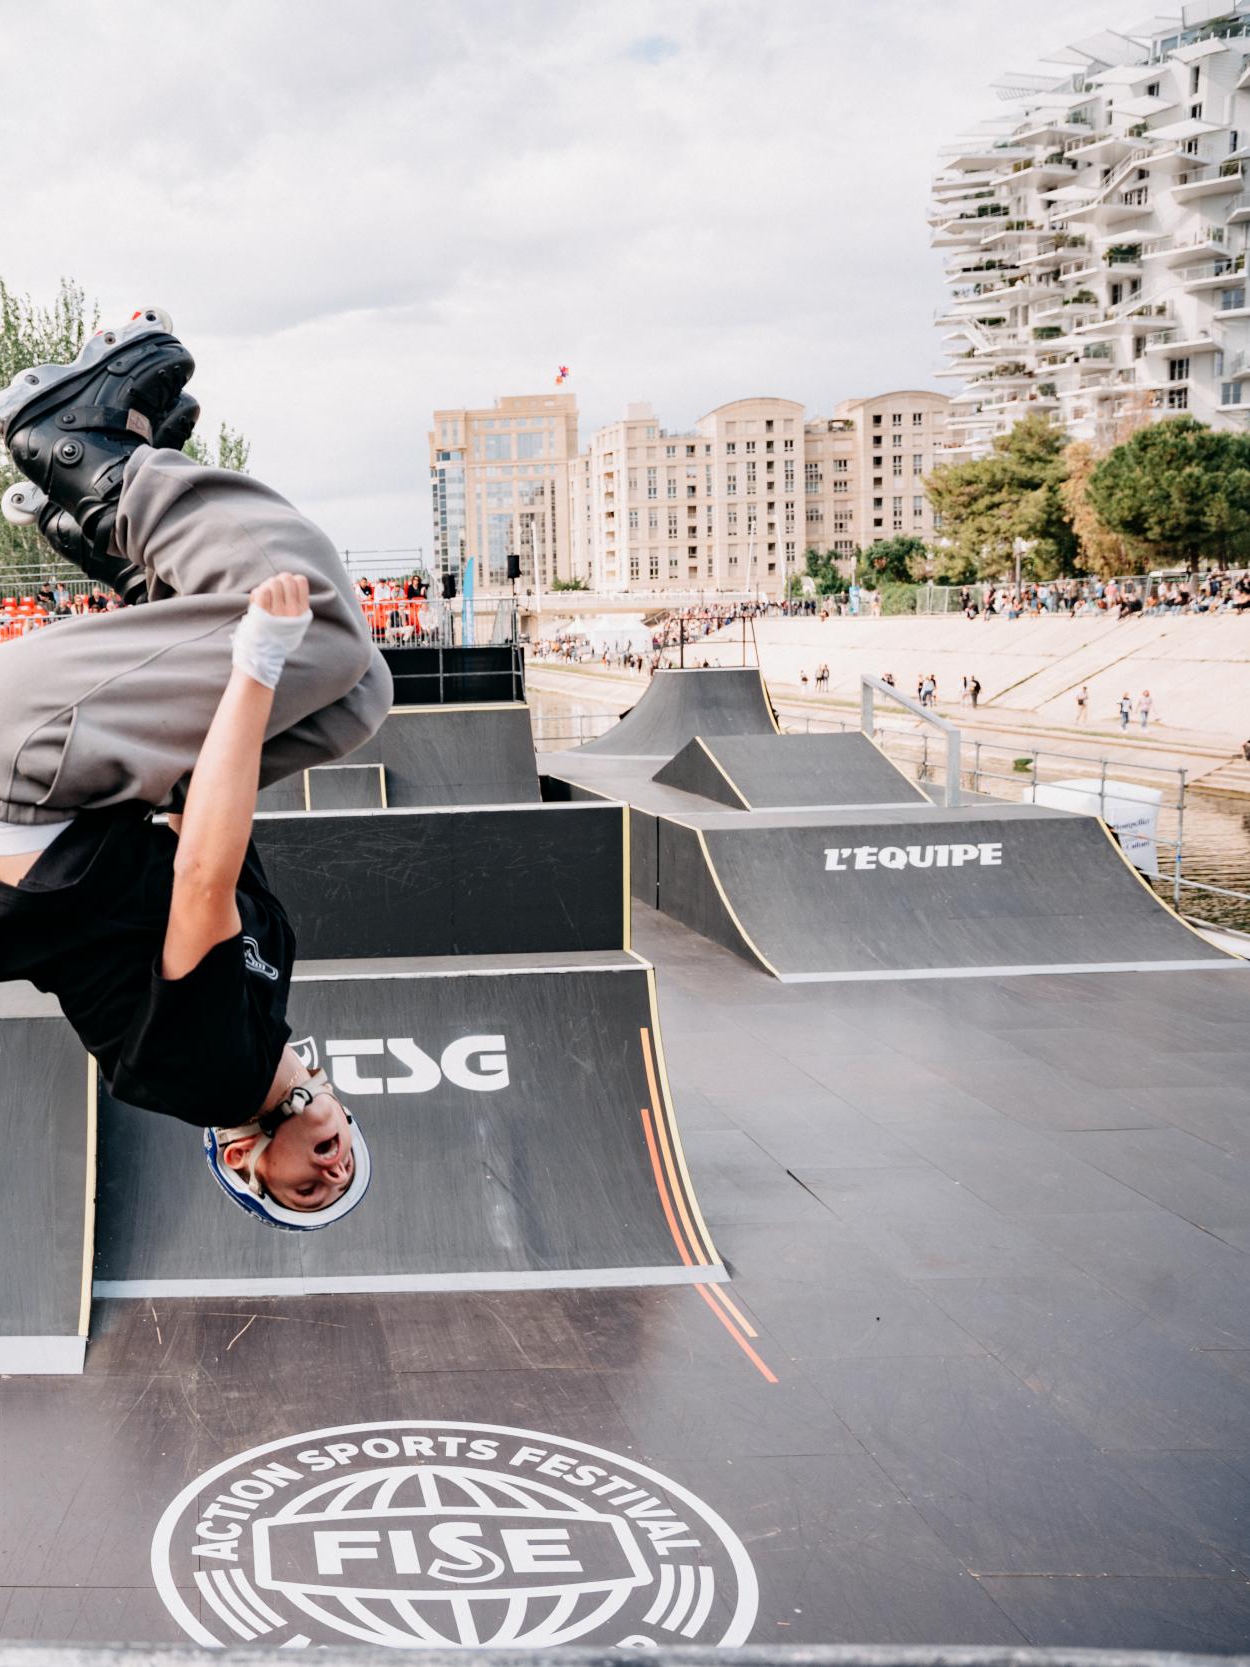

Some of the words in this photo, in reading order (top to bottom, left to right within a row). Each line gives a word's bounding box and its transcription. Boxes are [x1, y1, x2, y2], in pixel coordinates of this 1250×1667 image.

[325, 1034, 510, 1095] TSG
[191, 1461, 305, 1562] ACTION
[296, 1435, 500, 1472] SPORTS
[508, 1446, 702, 1556] FESTIVAL
[313, 1521, 584, 1584] FISE
